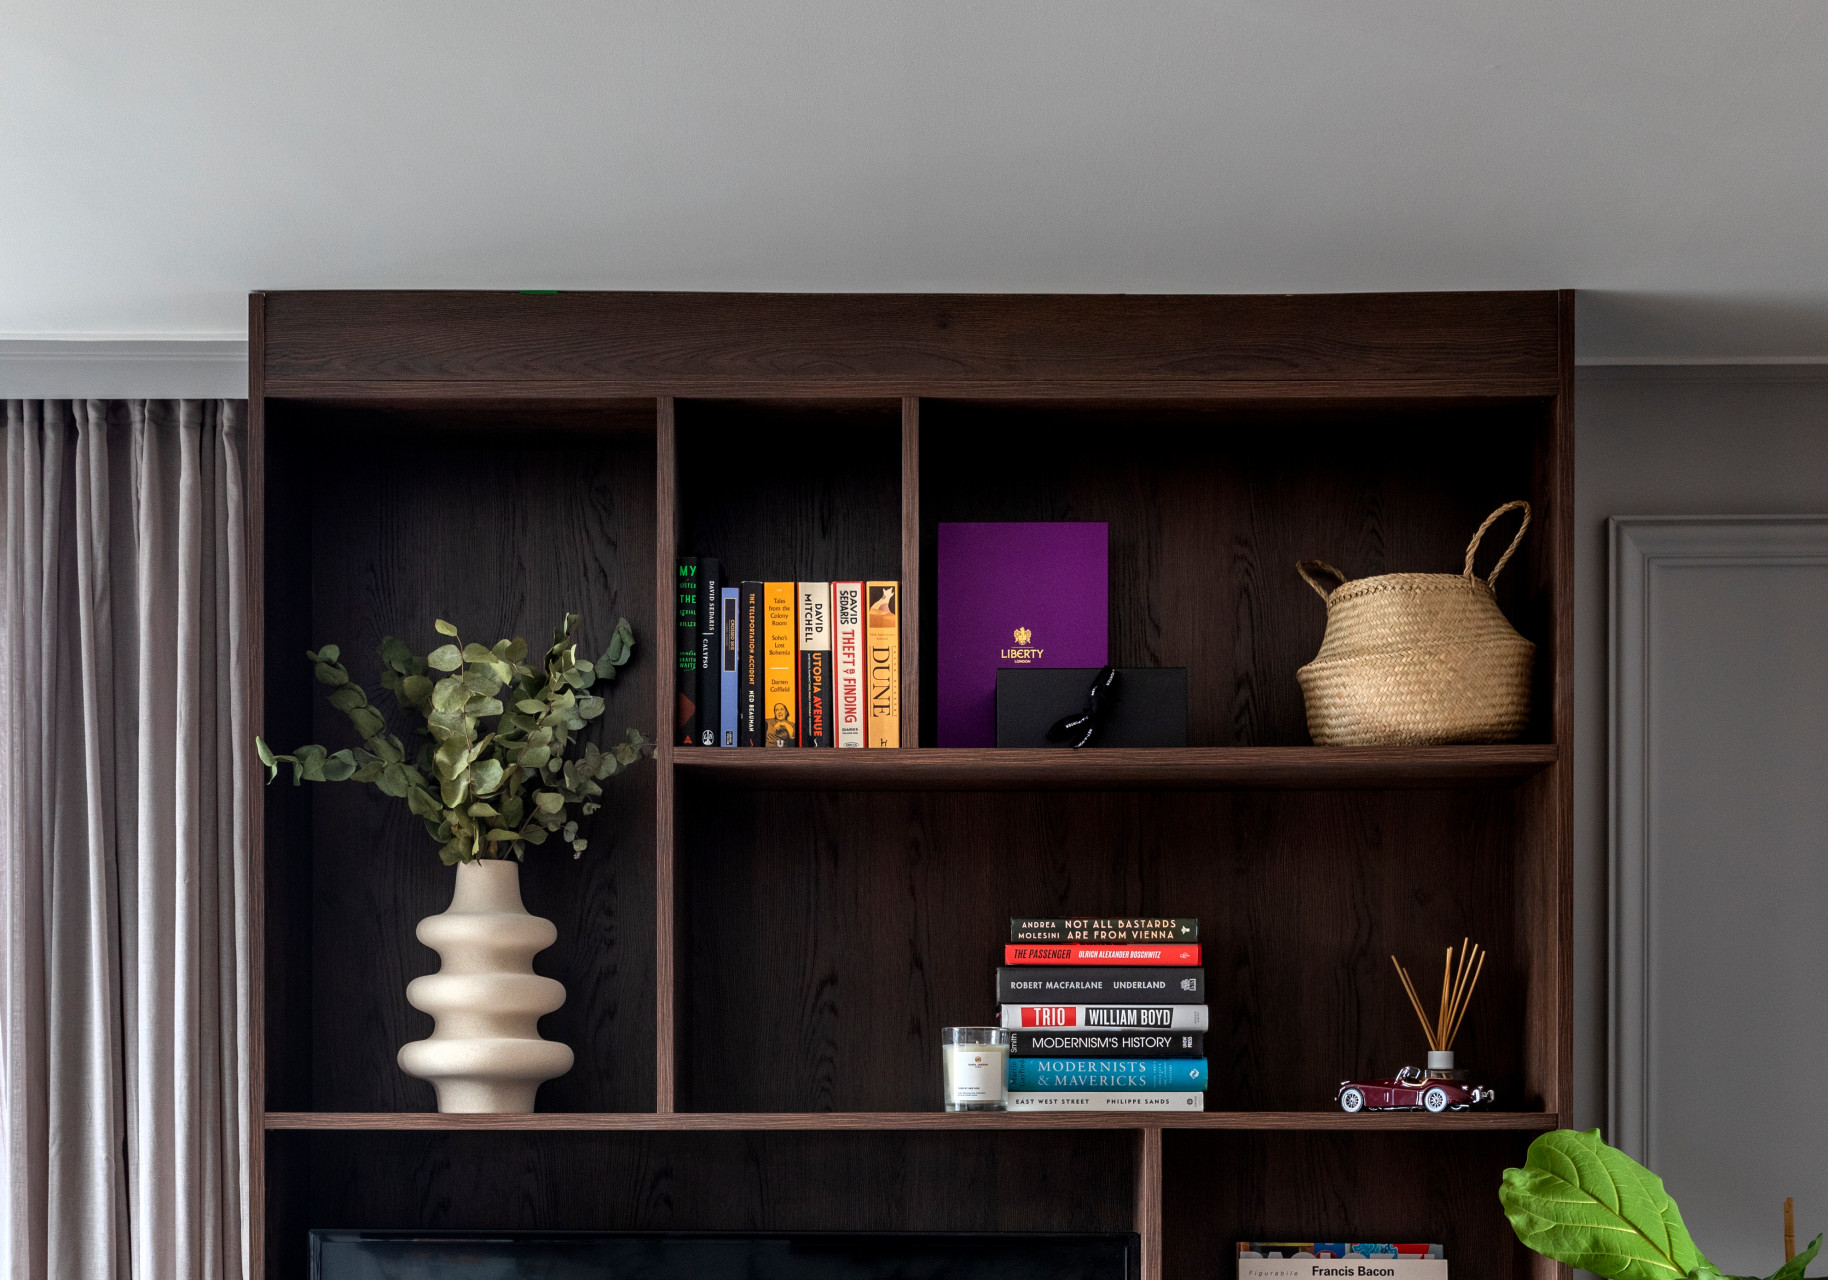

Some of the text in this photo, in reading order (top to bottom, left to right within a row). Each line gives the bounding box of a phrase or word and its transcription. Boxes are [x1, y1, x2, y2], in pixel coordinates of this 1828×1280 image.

[680, 565, 697, 577] MY
[679, 594, 697, 604] THE
[679, 609, 697, 617] SERIAL
[840, 590, 849, 625] SEDARIS
[850, 590, 858, 625] DAVID
[805, 594, 813, 643] MITCHELL
[815, 603, 823, 633] DAVID
[842, 629, 856, 666] THEFT
[1001, 649, 1044, 659] LIBERTY
[872, 646, 890, 718] DUNE
[812, 652, 823, 737] UTOPIA AVENUE
[844, 678, 857, 723] FINDING
[1022, 921, 1056, 929] ANDREA
[1065, 920, 1177, 929] NOT ALL BASTARDS
[1067, 930, 1174, 940] ARE FROM VIENNA
[1014, 949, 1072, 959] THE PASSENGER
[1098, 951, 1130, 959] ALEXANDER
[1129, 951, 1162, 959] BOSCHWITZ
[1010, 981, 1166, 990] ROBERT MACFARLANE UNDERLAND
[1034, 1007, 1171, 1026] TRIO WILLIAM BOYD
[1010, 1033, 1018, 1053] Smith
[1032, 1037, 1172, 1048] MODERNISM'S HISTORY
[1038, 1061, 1147, 1072] MODERNISTS
[1038, 1075, 1147, 1086] & MAVERICKS
[1312, 1266, 1395, 1277] Francis Bacon
